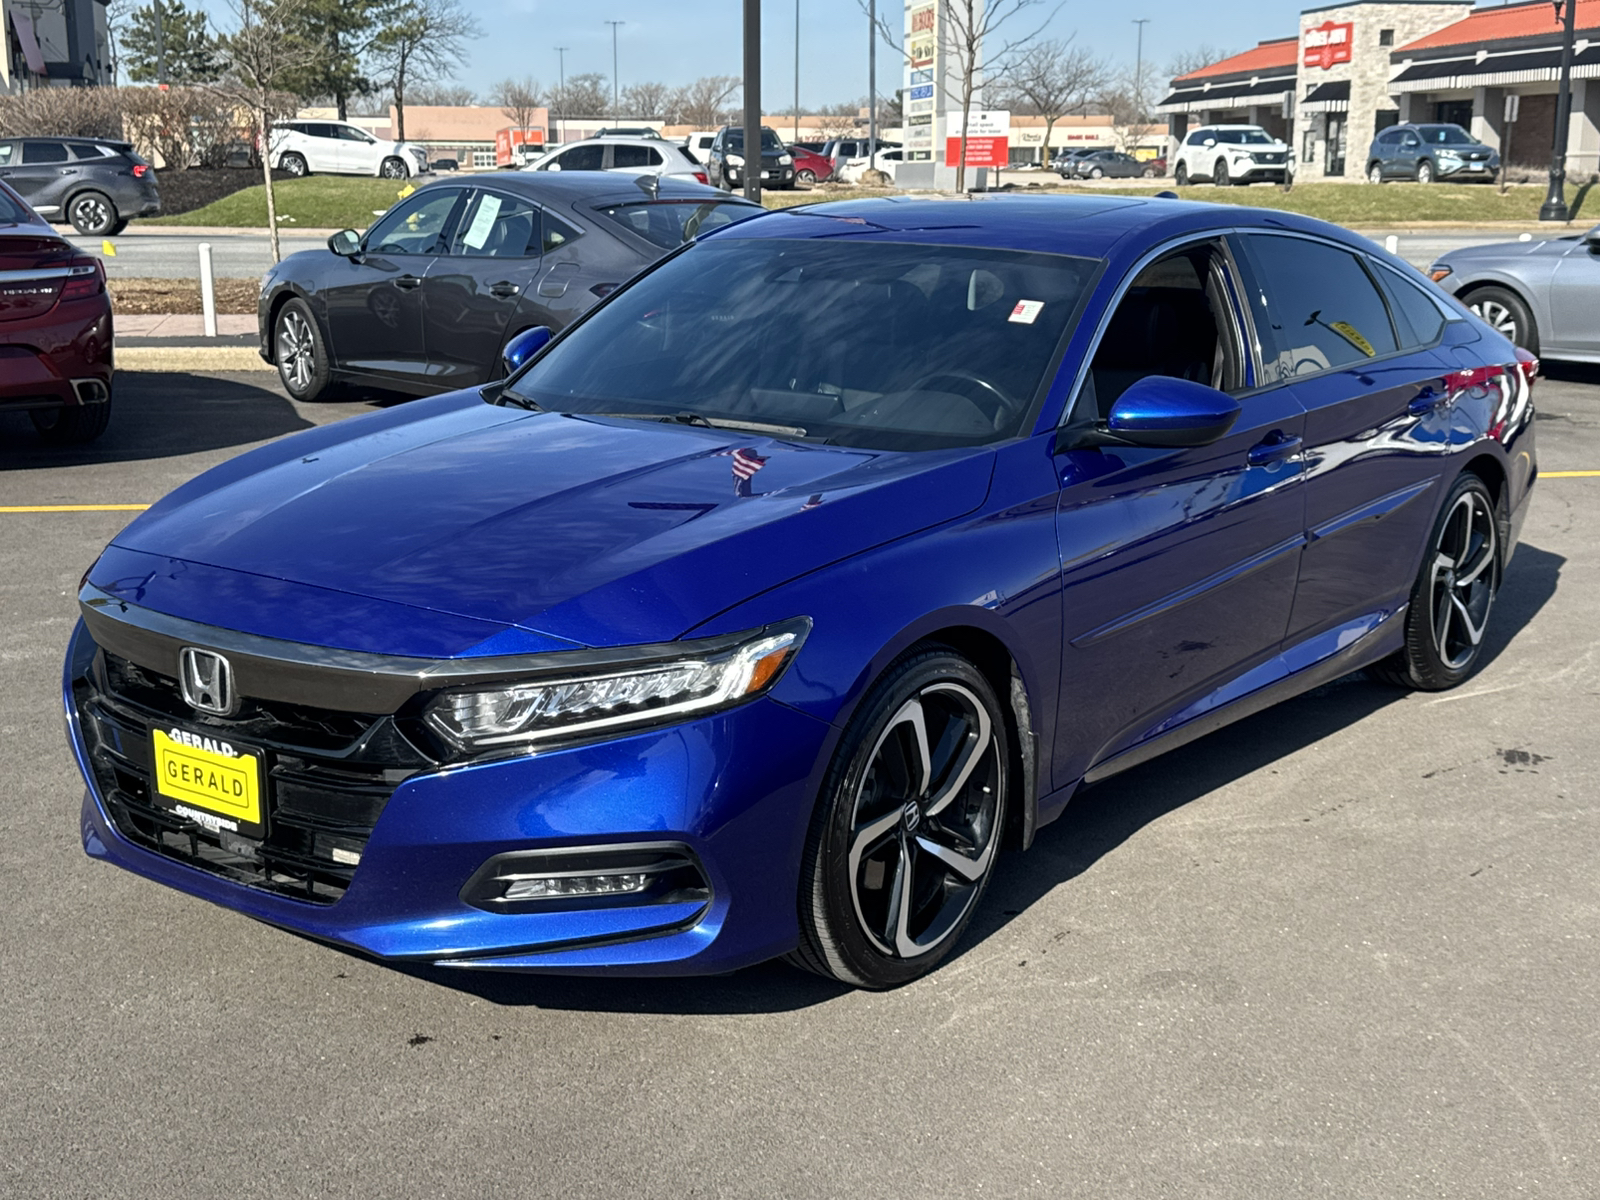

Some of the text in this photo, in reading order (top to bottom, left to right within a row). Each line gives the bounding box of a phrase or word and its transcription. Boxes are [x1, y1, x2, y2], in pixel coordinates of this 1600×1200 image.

[170, 727, 234, 757] GERALD
[167, 760, 243, 797] GERALD
[175, 804, 238, 832] COUNTRYSIDE
